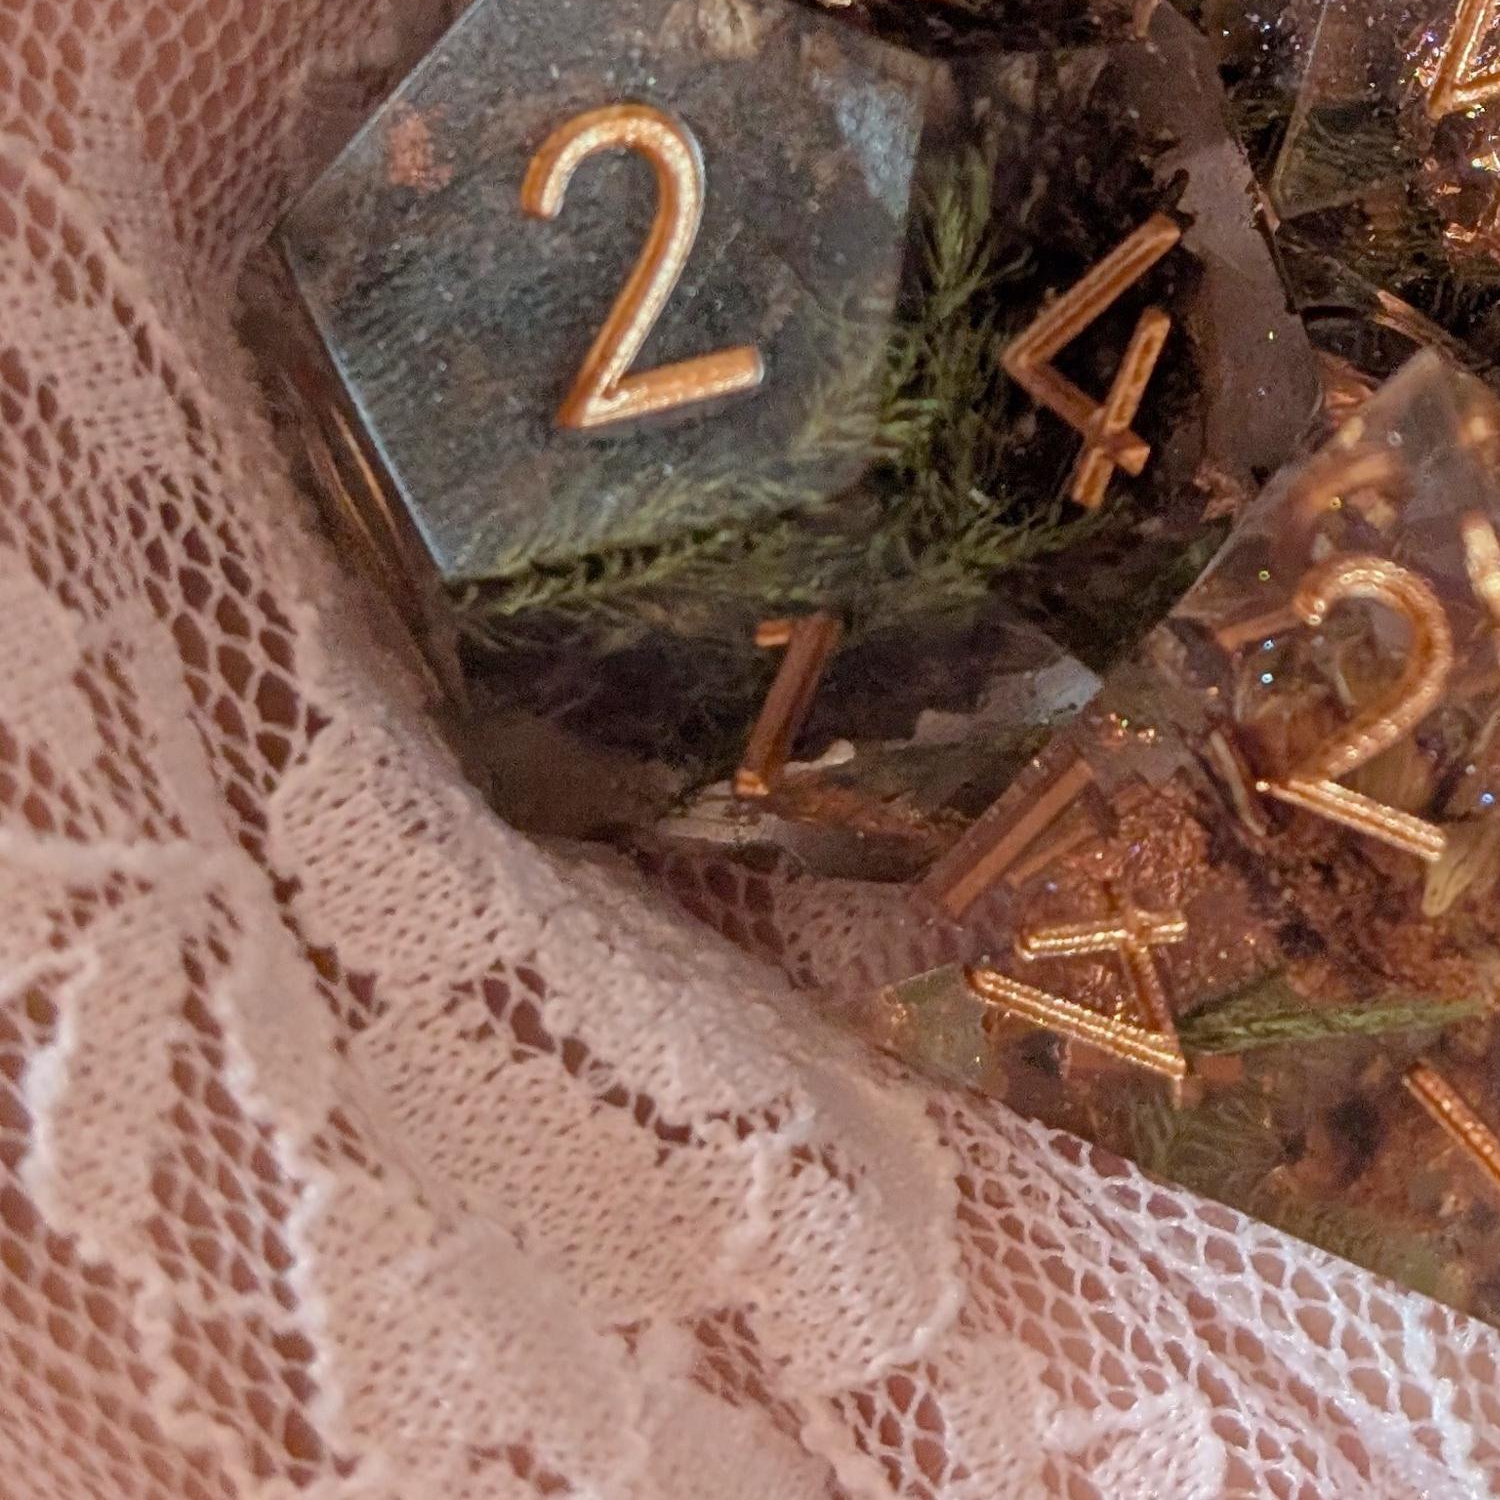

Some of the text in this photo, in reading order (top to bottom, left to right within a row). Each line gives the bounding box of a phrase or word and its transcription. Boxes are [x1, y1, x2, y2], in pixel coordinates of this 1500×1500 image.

[520, 102, 765, 430] 2
[1001, 212, 1184, 508] 4
[1254, 554, 1458, 866] 2
[964, 908, 1190, 1082] 4
